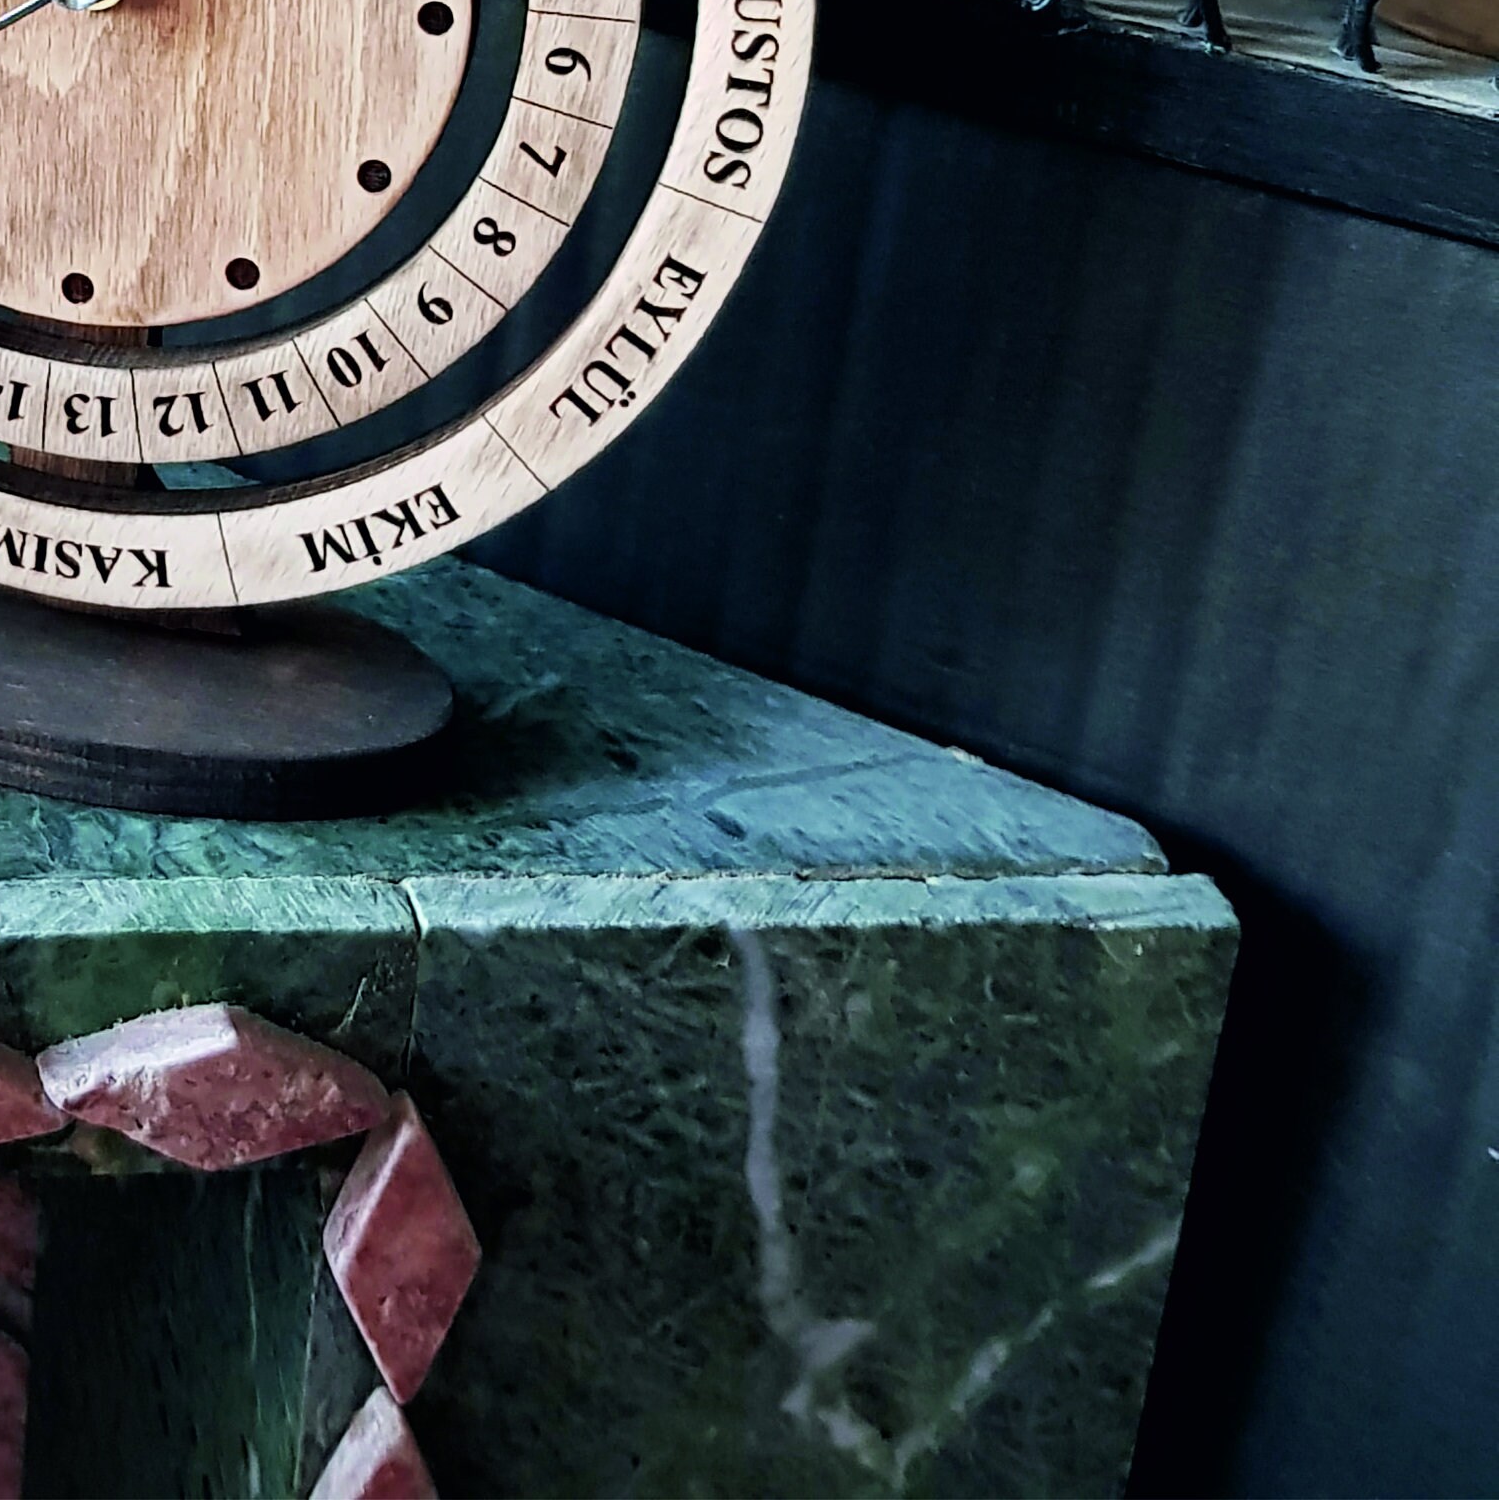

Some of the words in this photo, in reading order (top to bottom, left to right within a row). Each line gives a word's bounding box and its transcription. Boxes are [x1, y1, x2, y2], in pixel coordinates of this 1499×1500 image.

[544, 46, 592, 83] 6
[519, 140, 568, 178] 7
[472, 216, 517, 258] 8
[416, 281, 455, 326] 9
[325, 328, 391, 389] 10
[548, 252, 709, 428] EYLÜL
[63, 392, 119, 439] 13
[152, 390, 214, 439] 12
[241, 369, 302, 423] 11
[299, 481, 462, 574] EKİM
